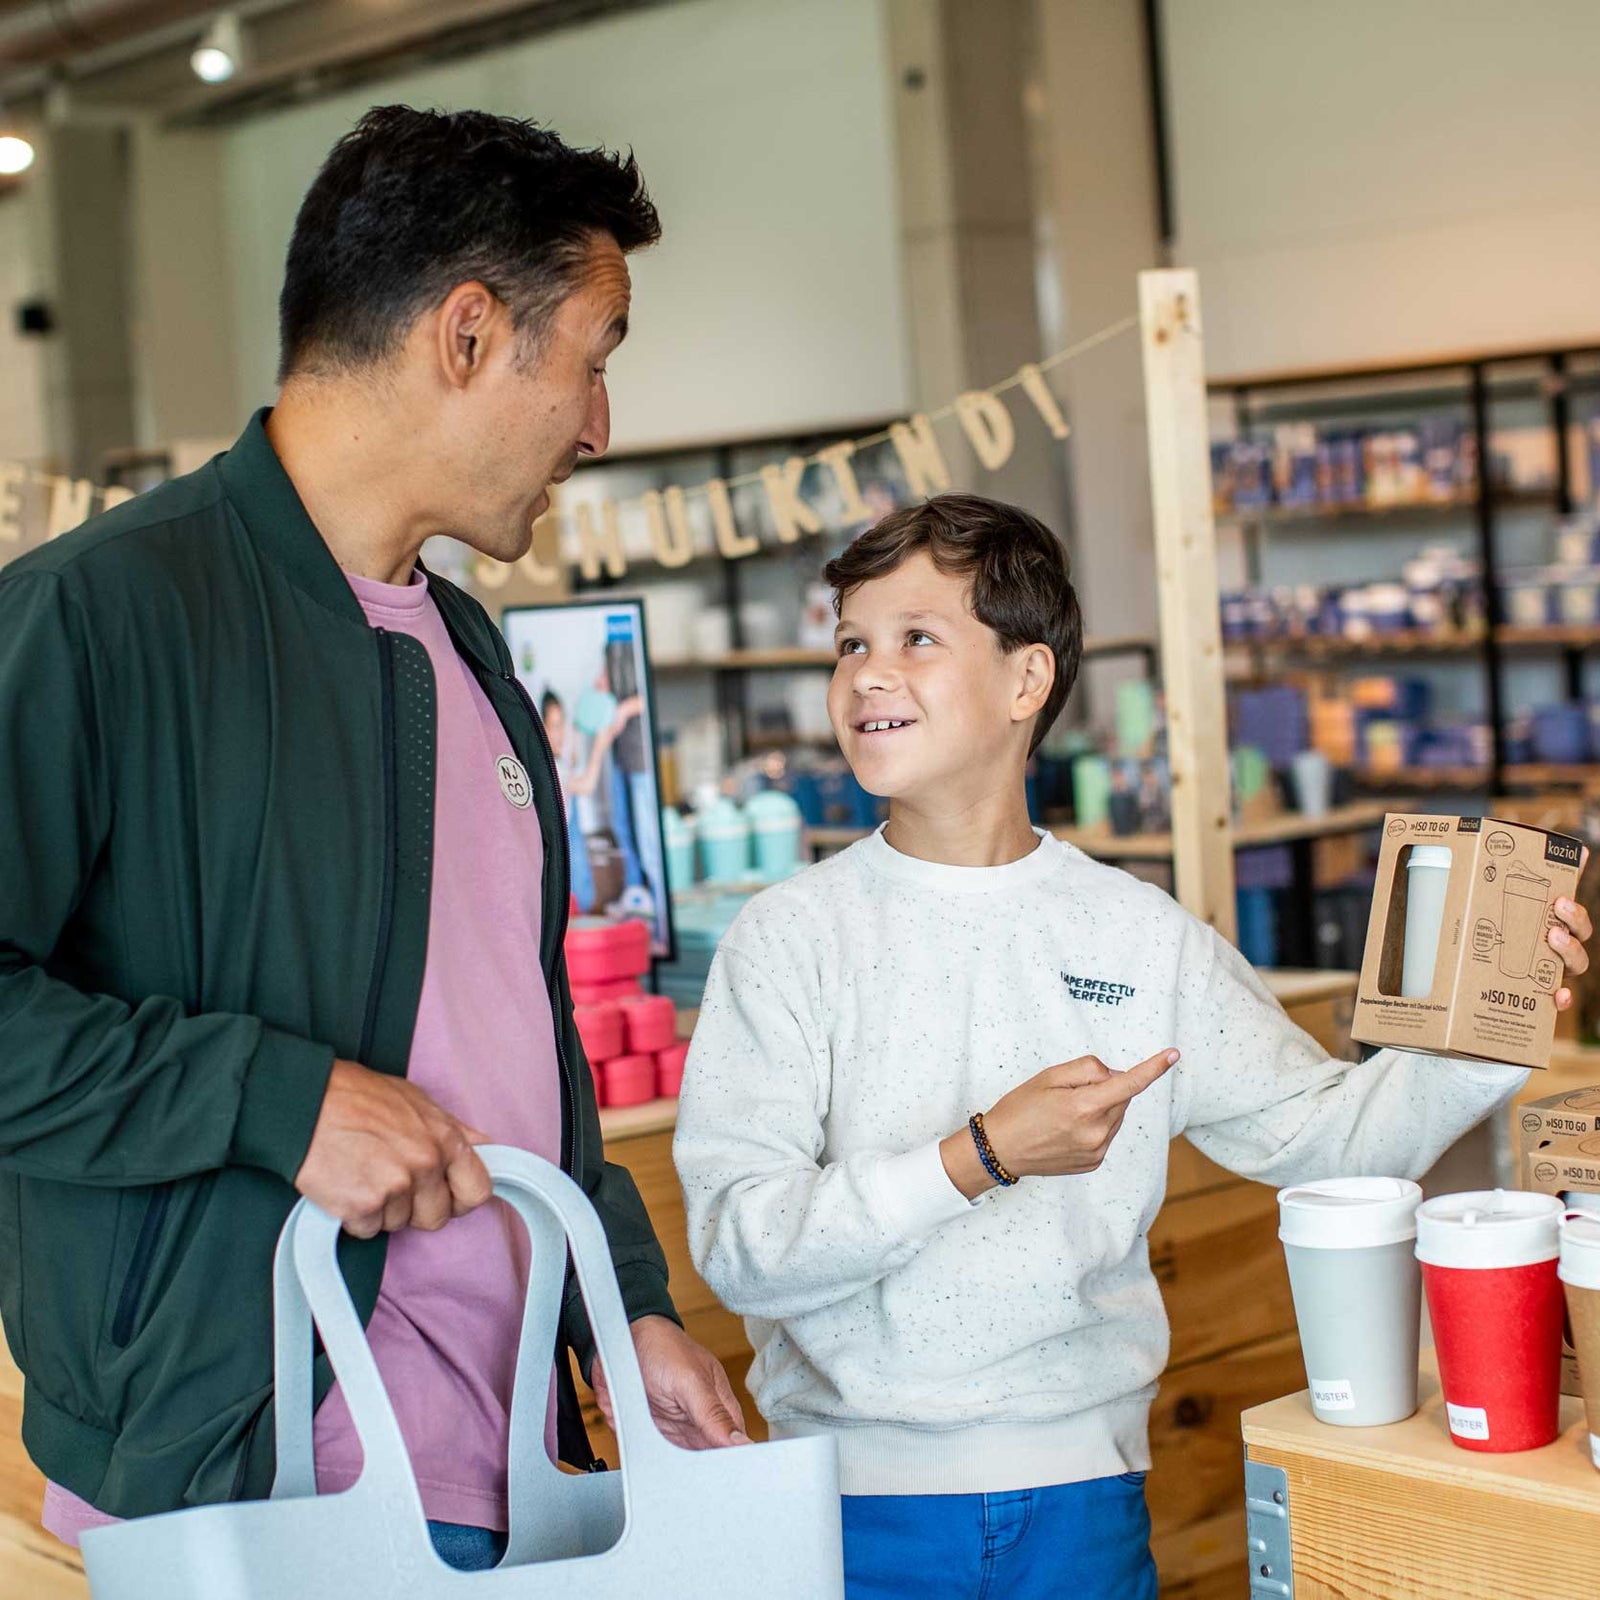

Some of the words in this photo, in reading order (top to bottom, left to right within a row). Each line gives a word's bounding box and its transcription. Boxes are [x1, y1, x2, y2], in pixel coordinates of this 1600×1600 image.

[501, 765, 518, 780] NJ
[508, 783, 525, 797] CO
[1429, 822, 1438, 832] TO
[1439, 822, 1450, 832] GO
[1547, 840, 1578, 861] koziol
[1508, 993, 1520, 1008] TO
[1522, 996, 1537, 1011] GO
[1565, 1120, 1575, 1130] TO
[1575, 1121, 1587, 1132] GO
[1585, 1168, 1596, 1180] TO
